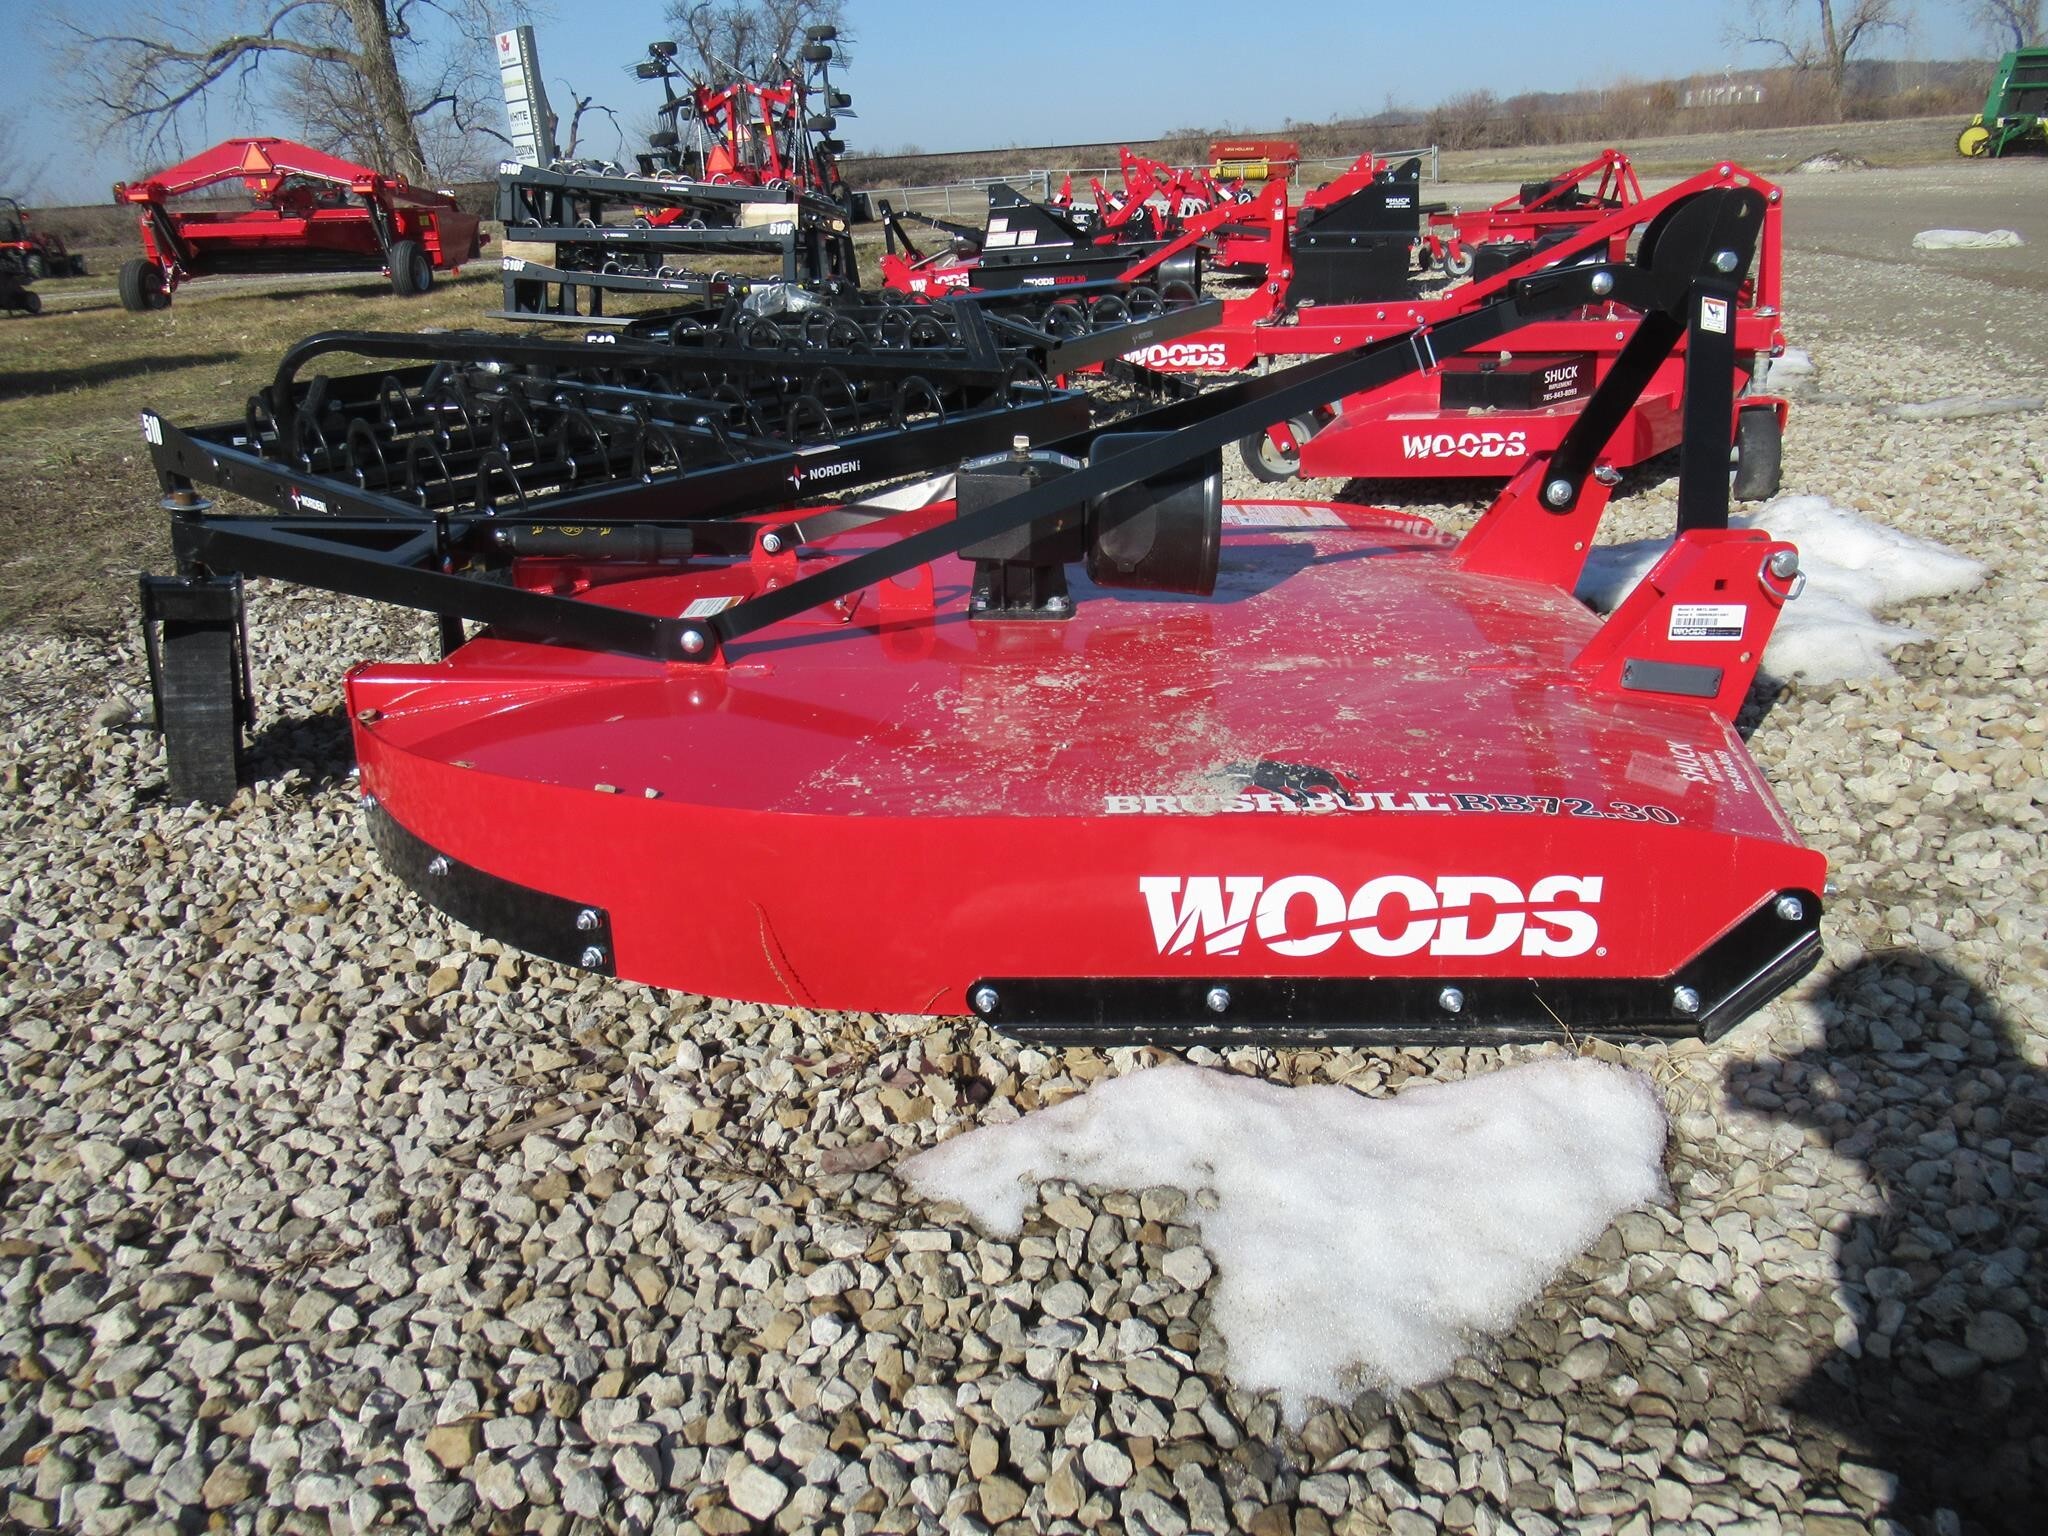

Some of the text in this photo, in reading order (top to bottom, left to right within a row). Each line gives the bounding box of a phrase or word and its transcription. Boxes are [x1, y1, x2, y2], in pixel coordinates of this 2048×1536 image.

[500, 162, 523, 175] 510F
[769, 222, 793, 235] 510F
[502, 258, 526, 272] 510F
[1544, 365, 1579, 384] SHUCK
[1548, 380, 1573, 391] IMPLEMENT
[142, 413, 164, 446] 510
[1402, 431, 1527, 458] WOODS
[809, 460, 857, 481] NORDEN
[1673, 627, 1708, 636] WOODS
[1665, 739, 1711, 785] SHUCK
[1452, 793, 1681, 825] BB72.30
[1139, 875, 1605, 959] WOODS
